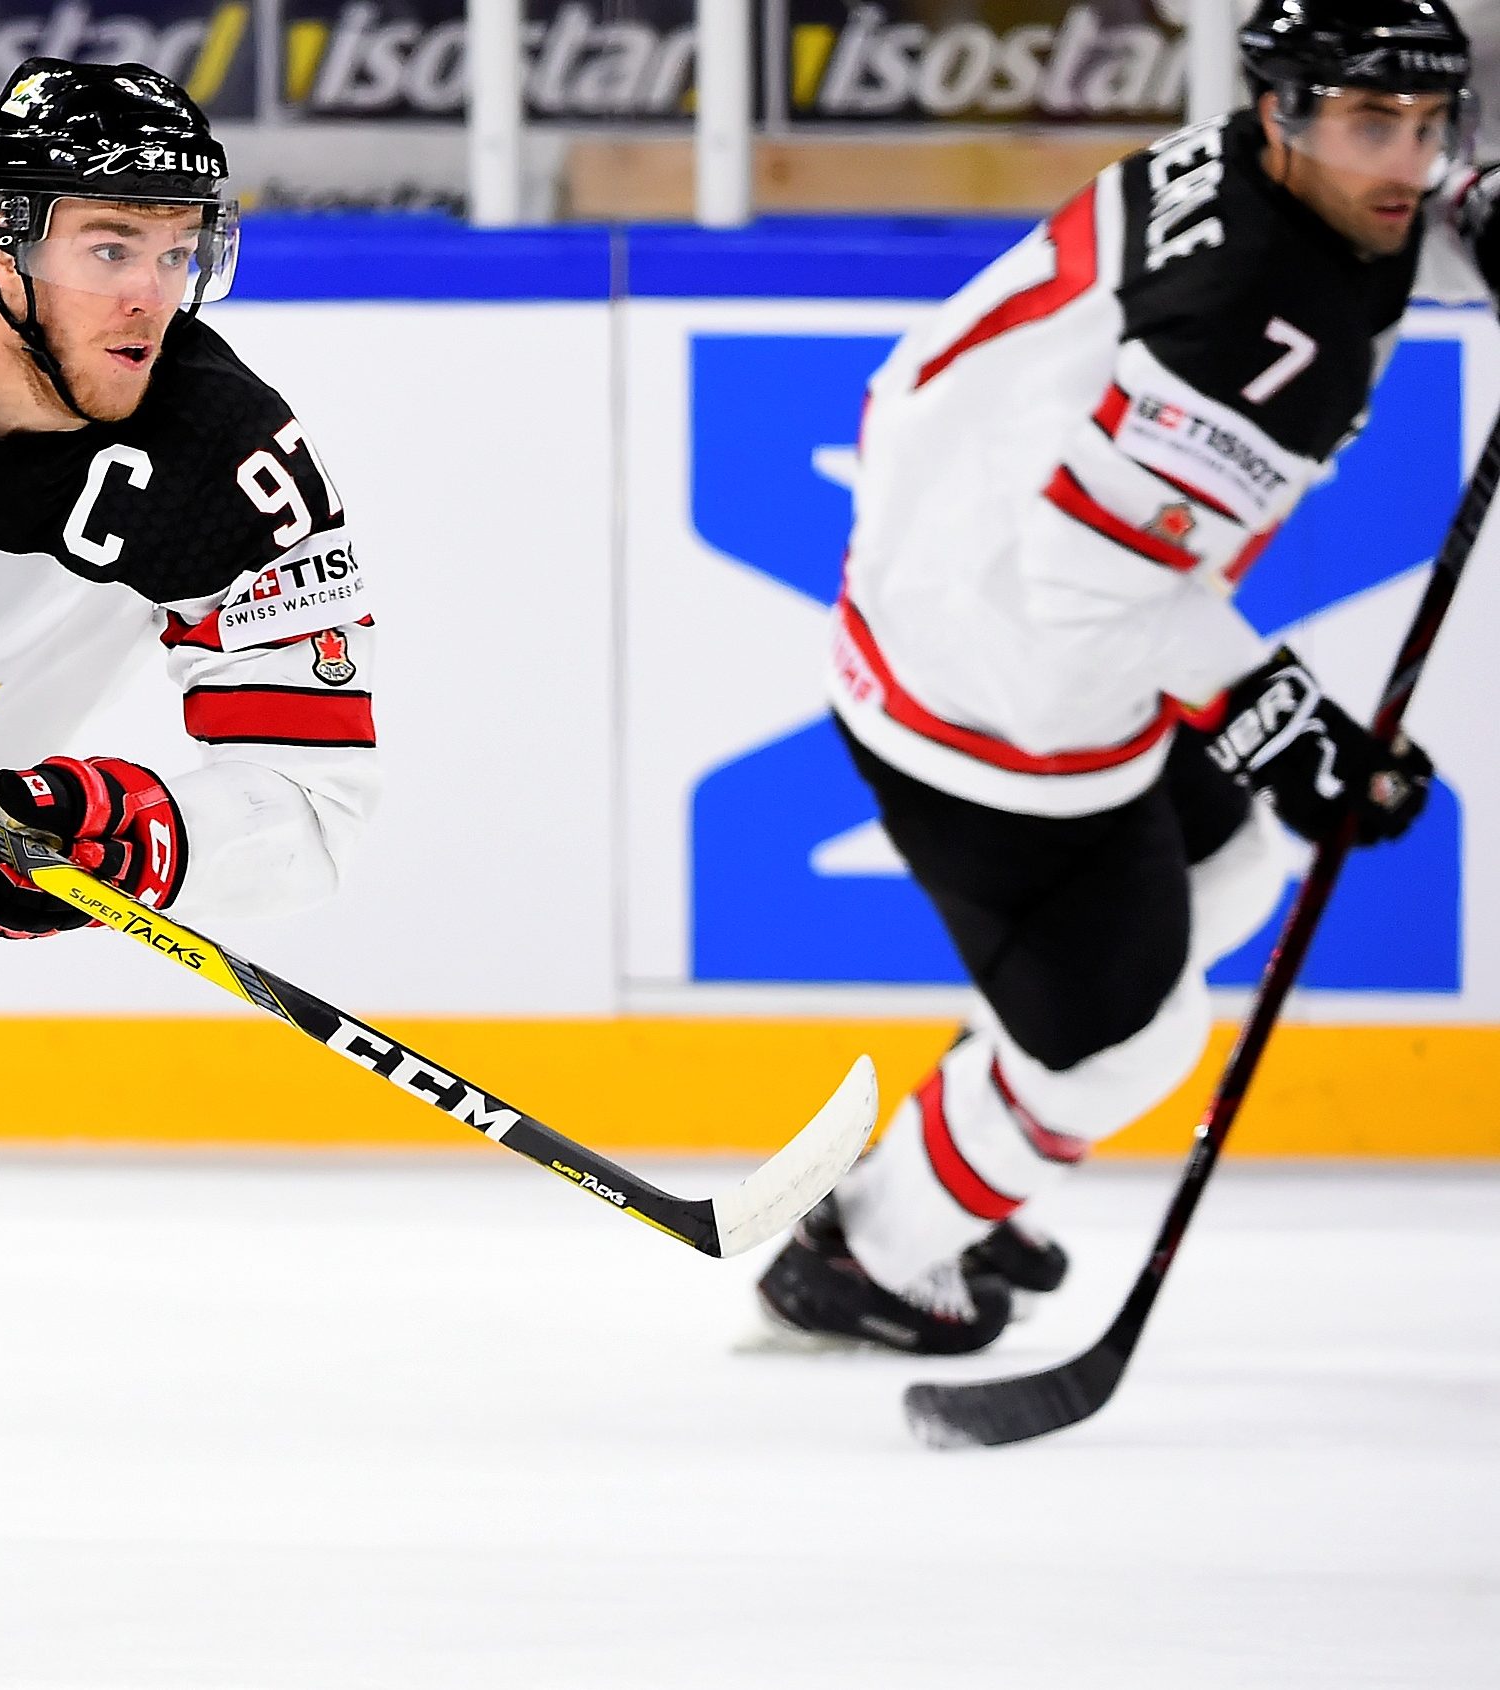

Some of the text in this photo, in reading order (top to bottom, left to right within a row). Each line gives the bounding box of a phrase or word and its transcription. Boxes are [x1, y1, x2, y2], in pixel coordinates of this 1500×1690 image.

[142, 149, 221, 177] TELUS
[1145, 114, 1227, 272] ERLE
[1240, 316, 1319, 405] 7
[63, 443, 153, 567] C
[237, 418, 343, 548] 97
[225, 585, 351, 628] SWISS WATCHES
[68, 887, 207, 970] SUPER TACKS
[326, 1016, 522, 1143] CCM
[579, 1171, 627, 1206] TACKS
